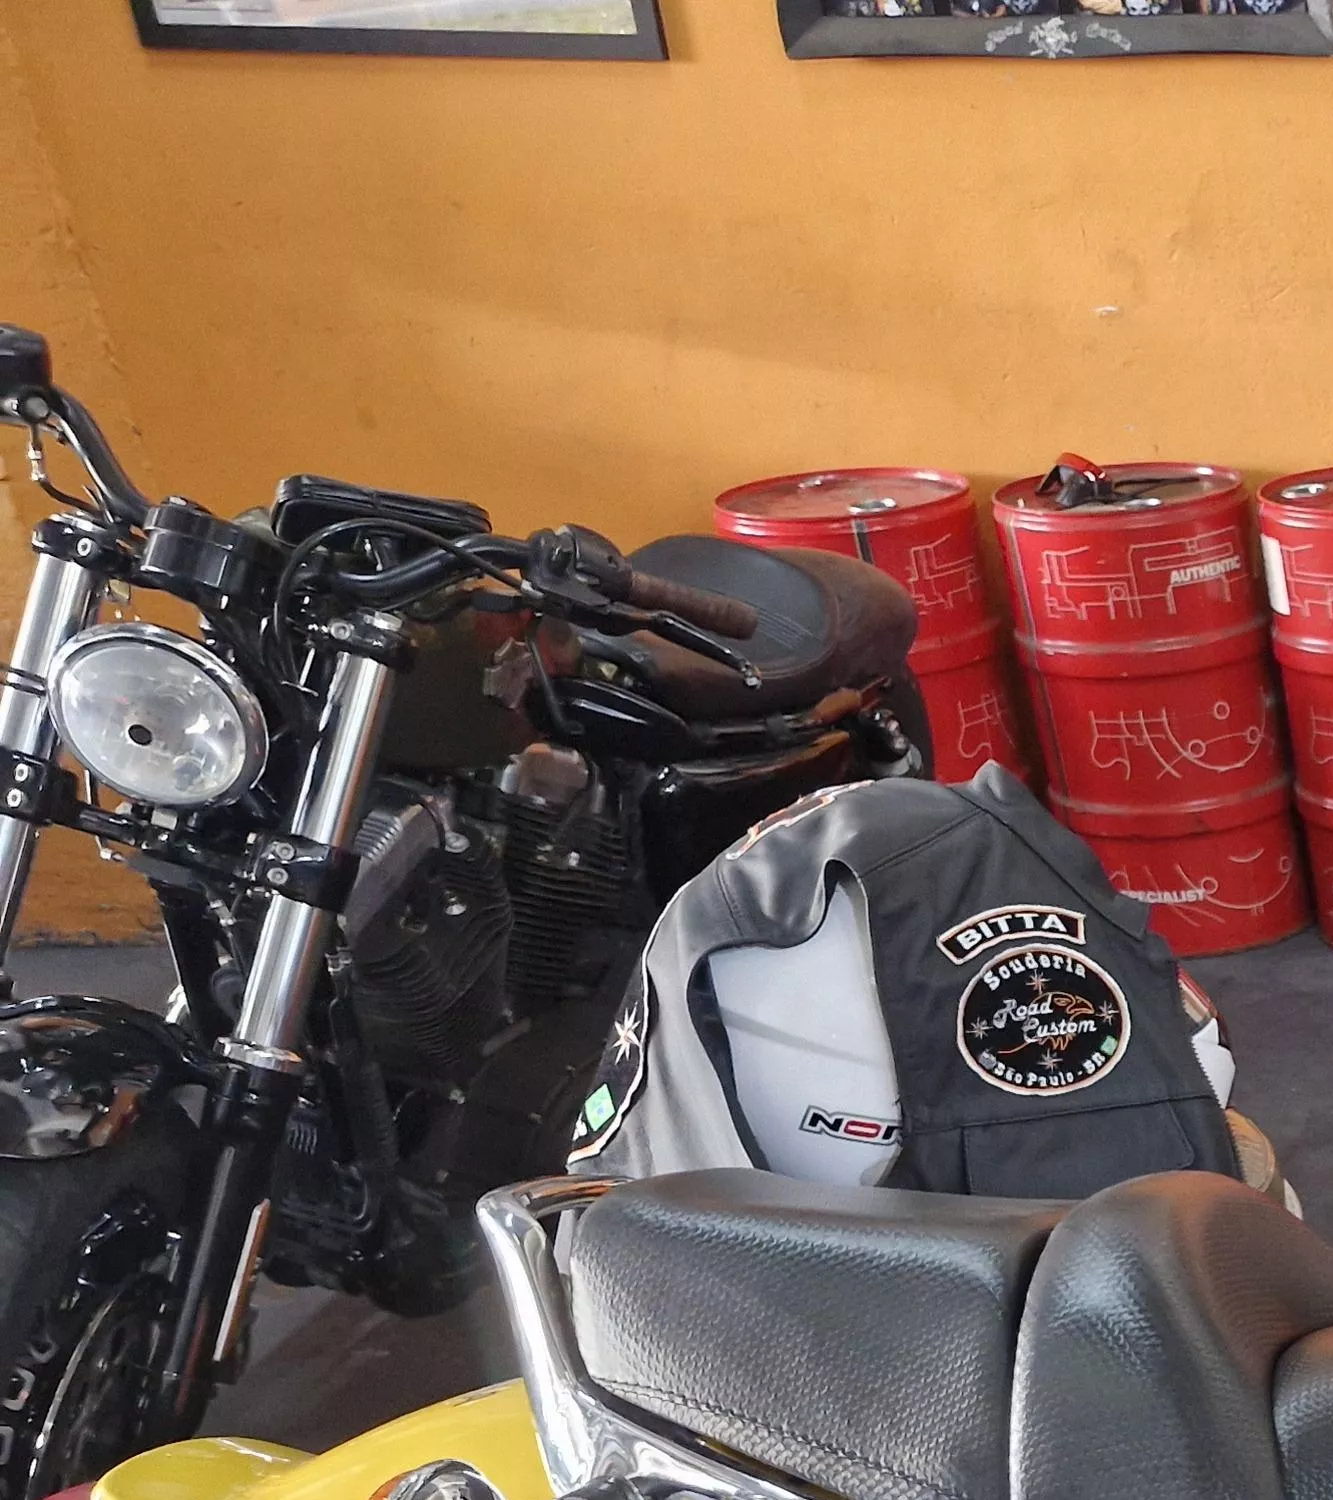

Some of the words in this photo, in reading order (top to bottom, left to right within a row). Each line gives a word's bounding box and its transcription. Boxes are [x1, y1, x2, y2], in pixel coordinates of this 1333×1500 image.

[1170, 554, 1241, 585] AUTHENTIC
[956, 912, 1068, 951] BITTA
[992, 993, 1054, 1029] Road
[1022, 1017, 1098, 1044] Custom
[1027, 1071, 1074, 1087] Paulo
